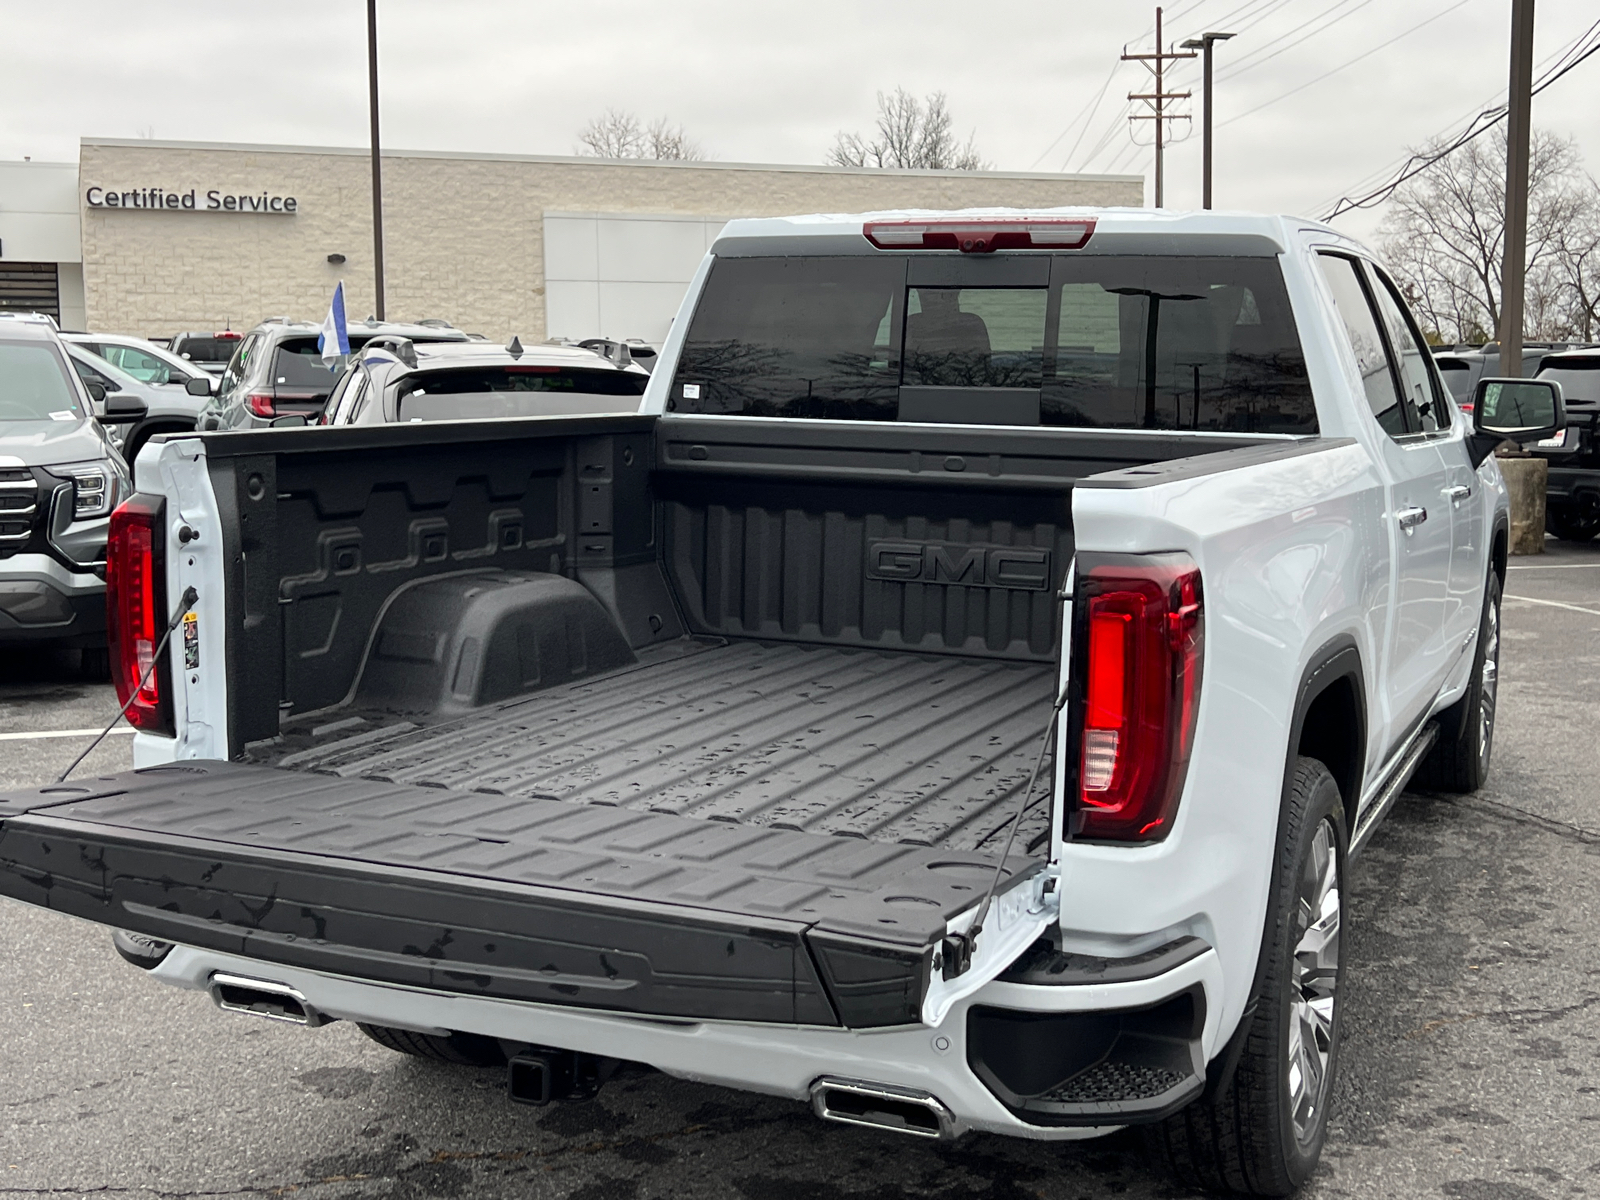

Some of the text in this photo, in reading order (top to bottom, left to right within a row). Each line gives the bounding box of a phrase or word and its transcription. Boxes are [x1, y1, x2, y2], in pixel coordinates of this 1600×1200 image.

[86, 187, 297, 212] Certified Service
[869, 542, 1047, 587] GMC
